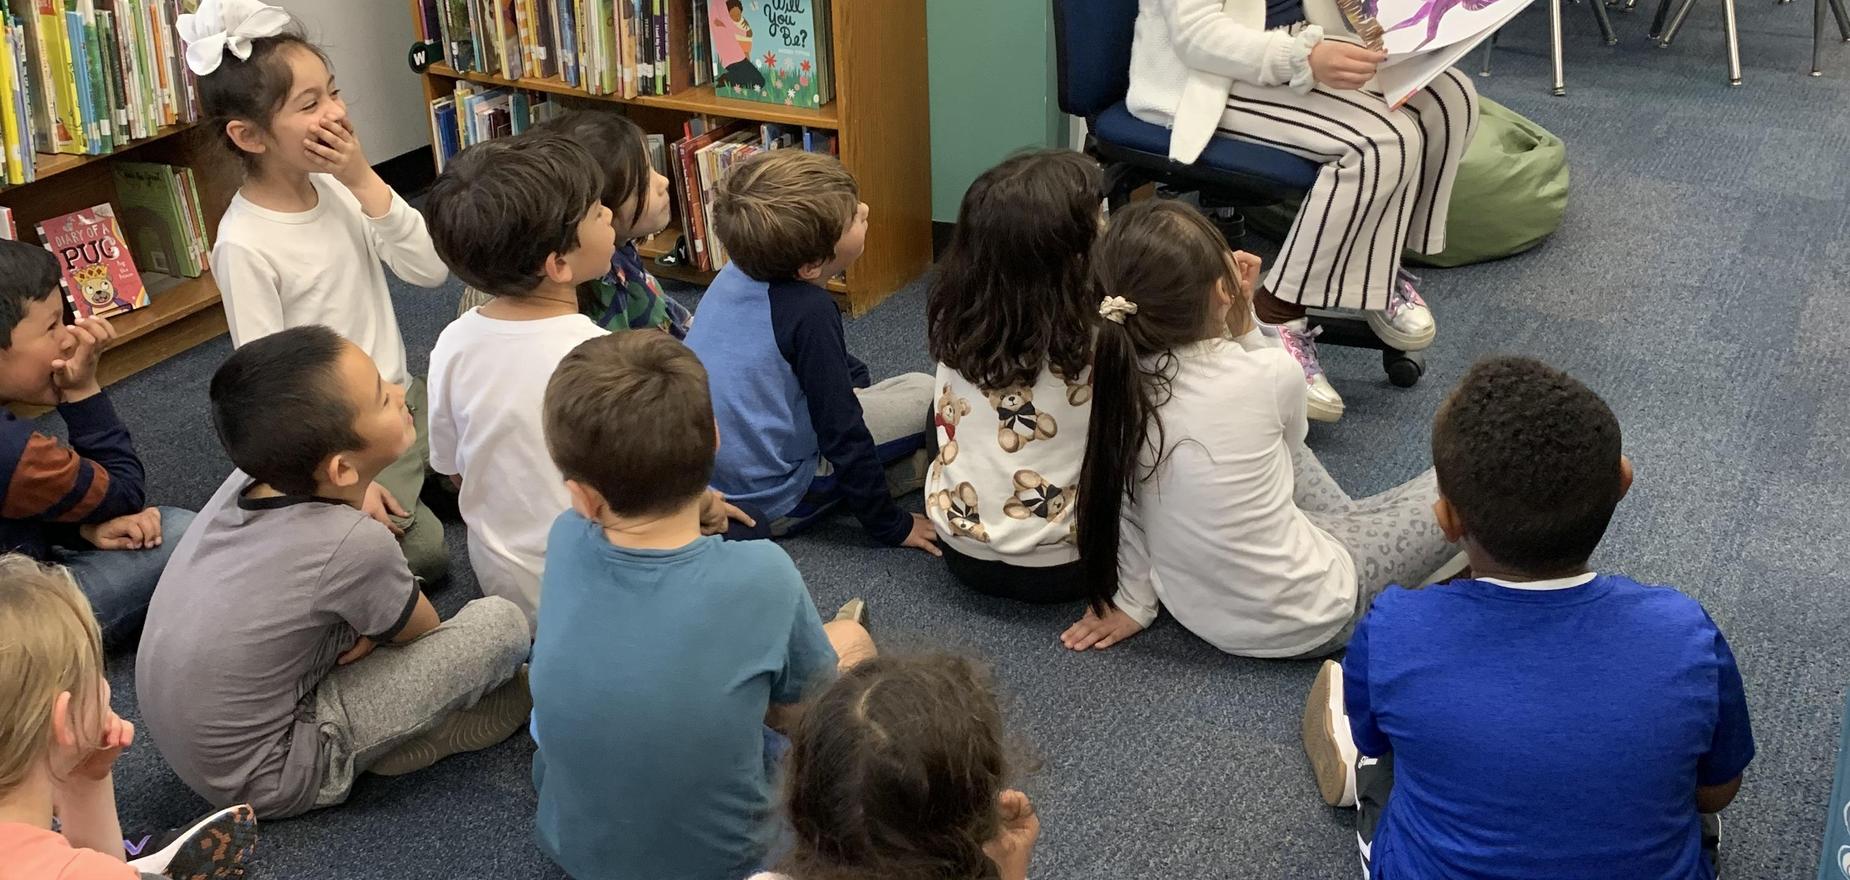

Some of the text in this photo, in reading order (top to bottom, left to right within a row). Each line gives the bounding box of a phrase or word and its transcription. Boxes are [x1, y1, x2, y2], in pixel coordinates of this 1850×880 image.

[772, 0, 804, 13] Will
[763, 3, 796, 37] You
[779, 26, 808, 48] Be?
[413, 50, 426, 66] W
[54, 222, 110, 248] DIARY OF A
[60, 235, 121, 271] PUG
